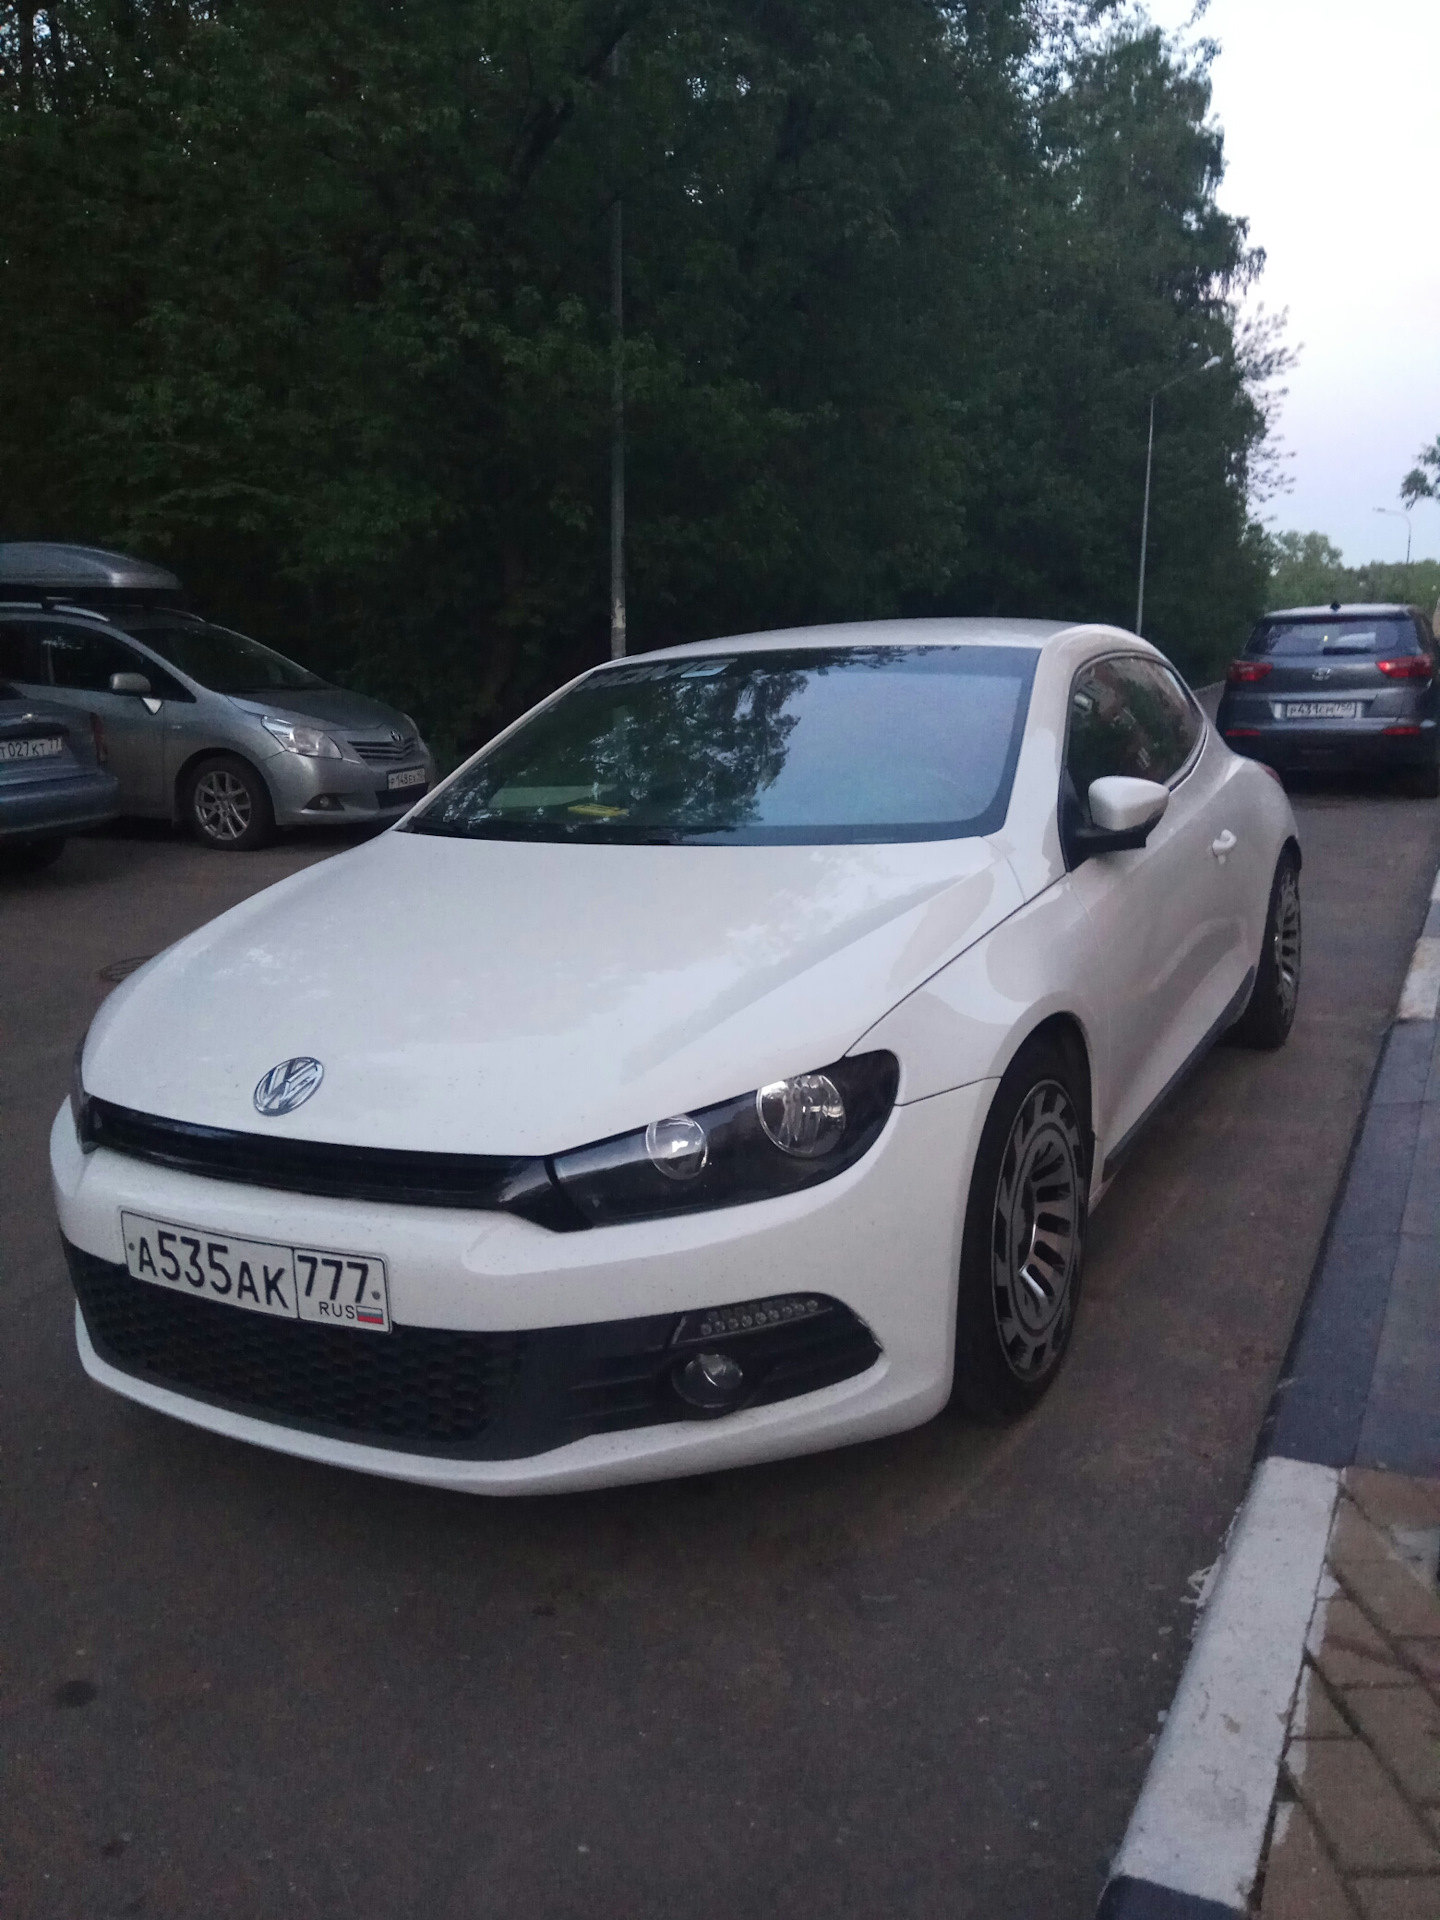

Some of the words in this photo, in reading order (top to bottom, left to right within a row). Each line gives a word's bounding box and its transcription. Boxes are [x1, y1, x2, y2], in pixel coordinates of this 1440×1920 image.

[138, 1230, 289, 1309] A535AK
[297, 1254, 369, 1304] 777
[318, 1301, 355, 1320] RUS
